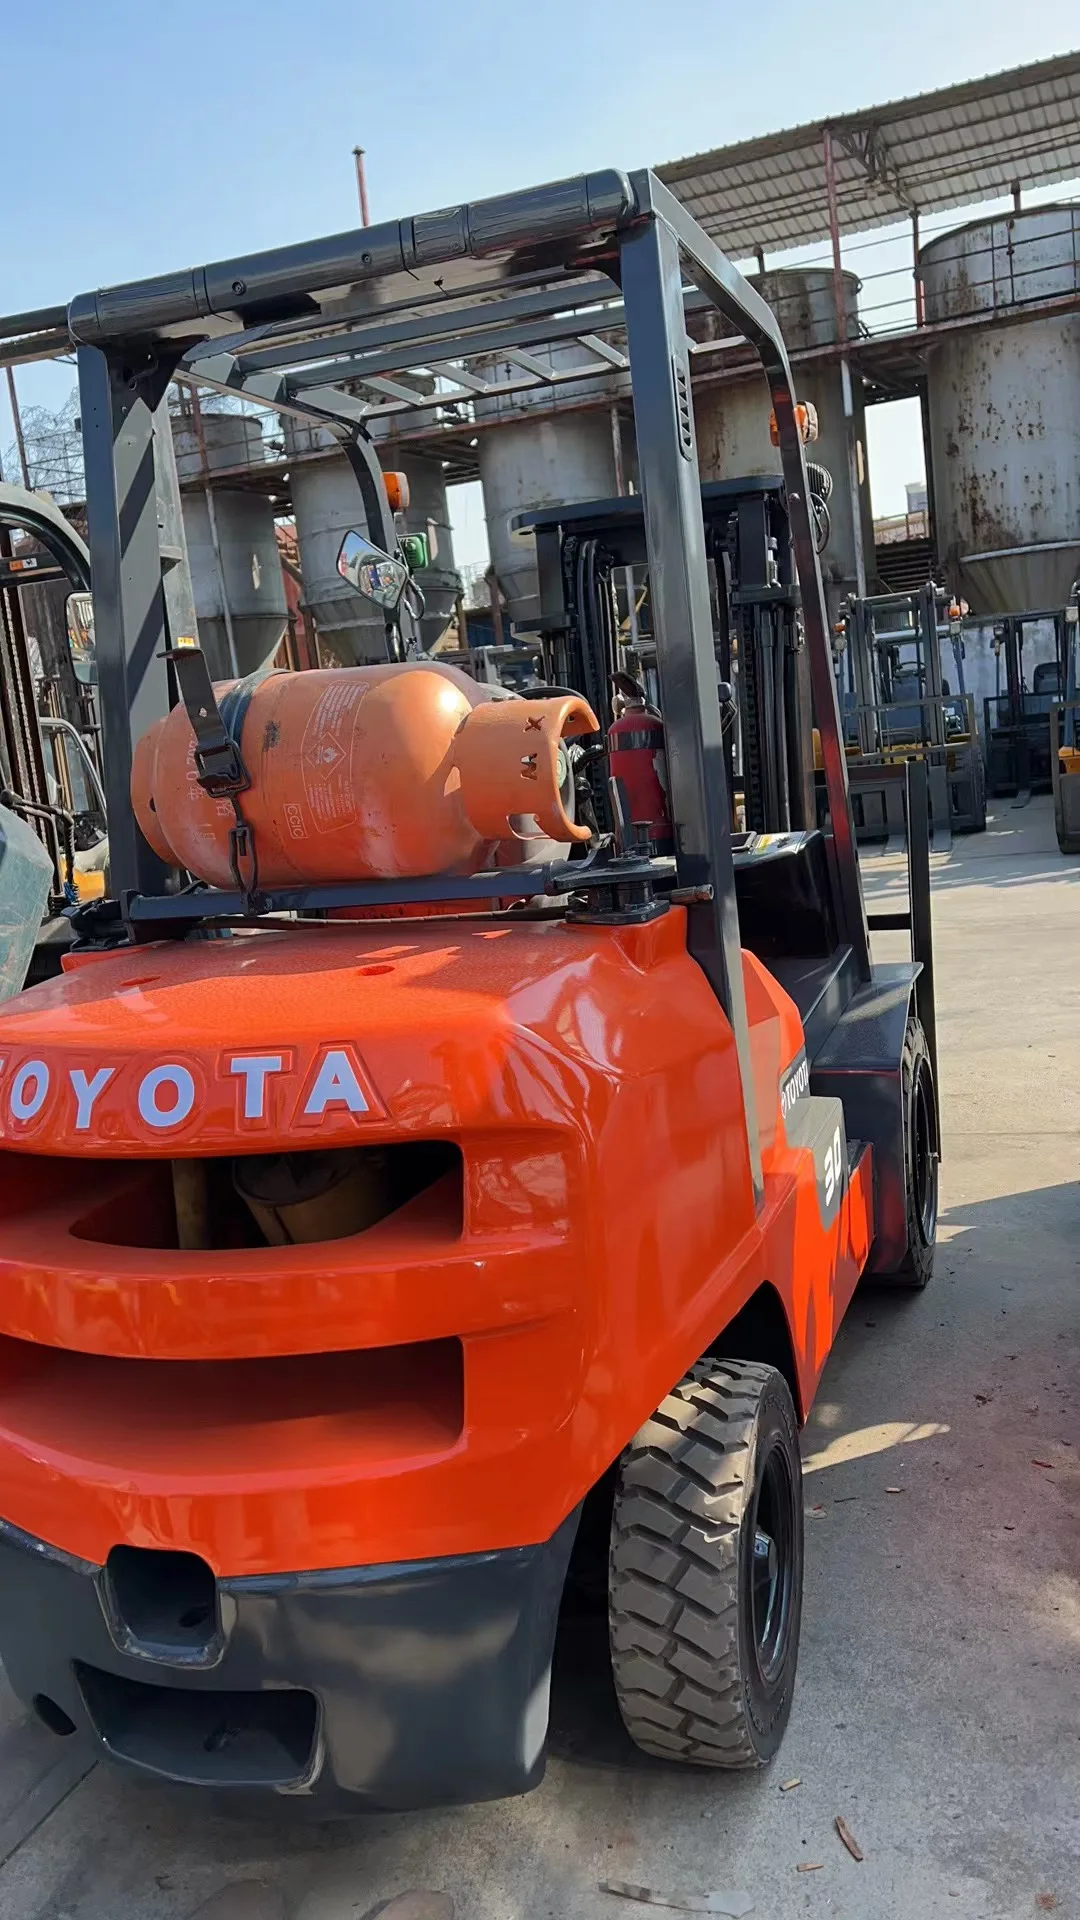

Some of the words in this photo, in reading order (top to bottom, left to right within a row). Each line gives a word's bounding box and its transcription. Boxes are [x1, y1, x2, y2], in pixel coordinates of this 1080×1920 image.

[287, 805, 304, 837] CCIC
[0, 1051, 369, 1129] OYOTA
[824, 1125, 841, 1206] 30
